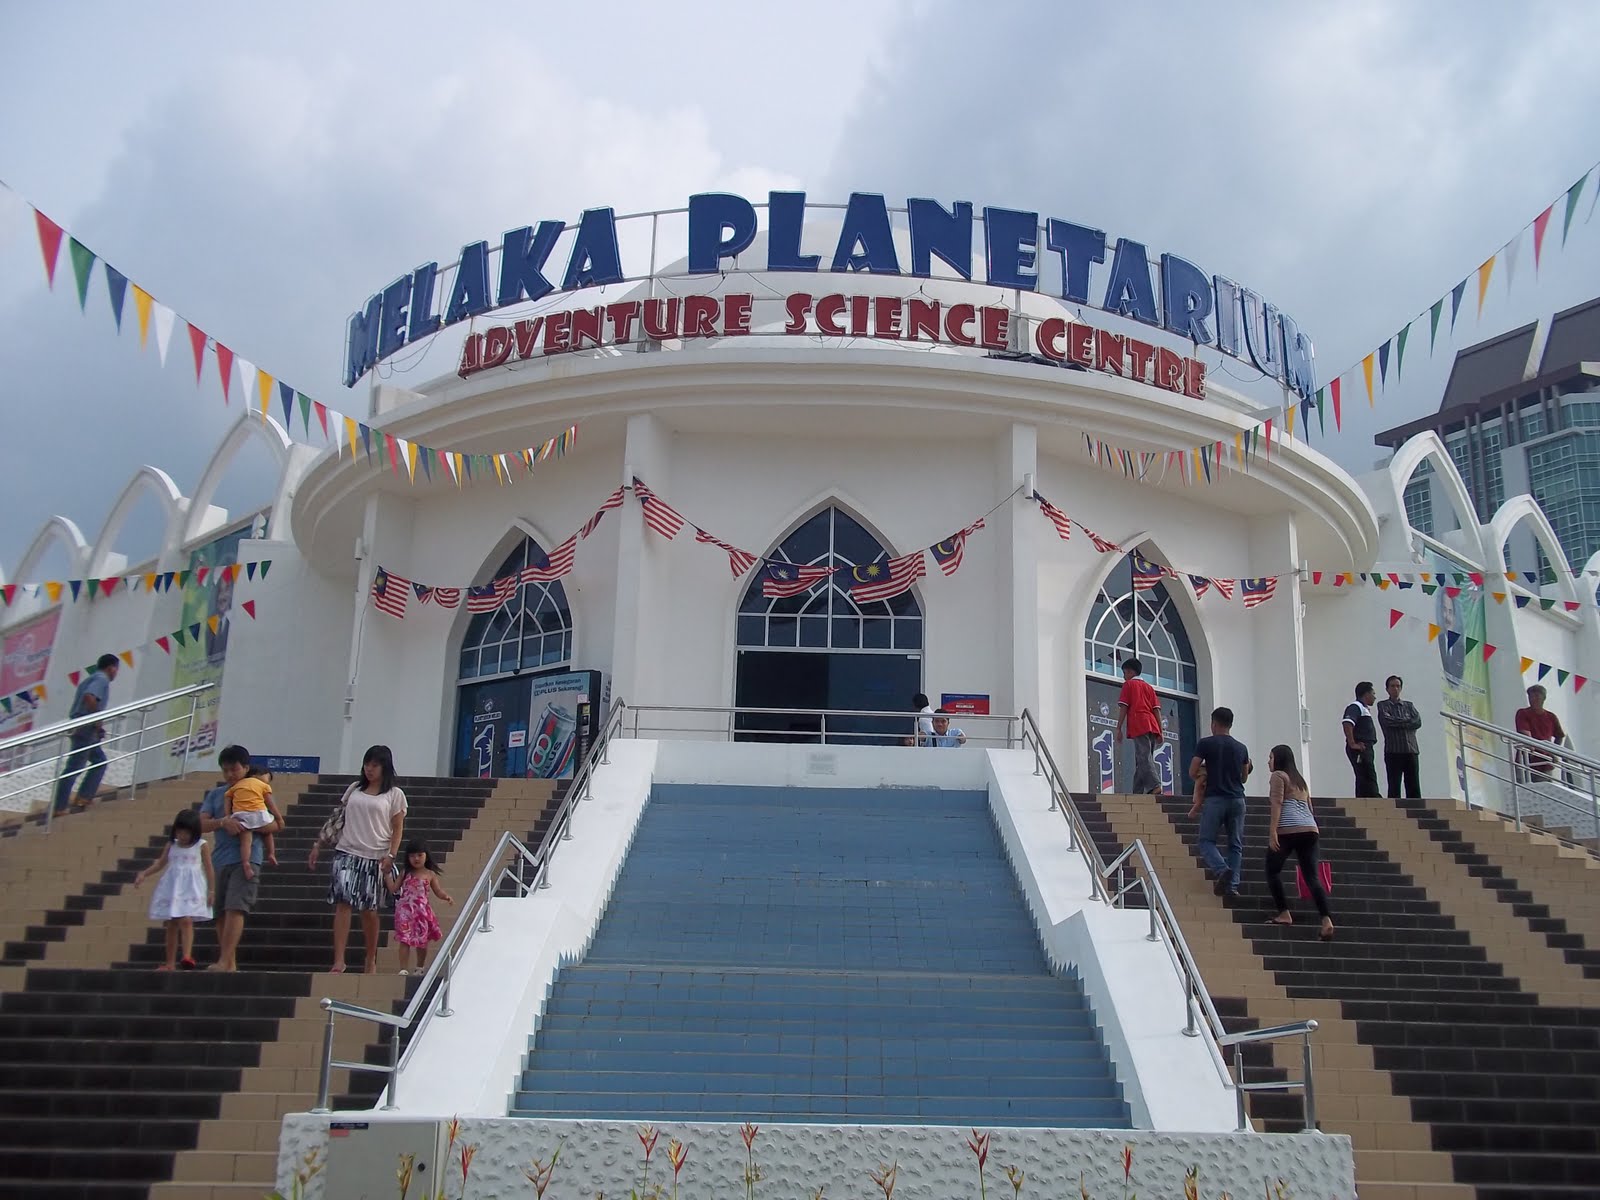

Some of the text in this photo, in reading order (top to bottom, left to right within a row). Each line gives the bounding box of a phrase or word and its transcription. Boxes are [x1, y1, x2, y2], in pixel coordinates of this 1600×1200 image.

[342, 190, 1318, 406] MELAKA PLANETARIUM
[457, 293, 1208, 400] ADVENTURE SCIENCE CENTRE
